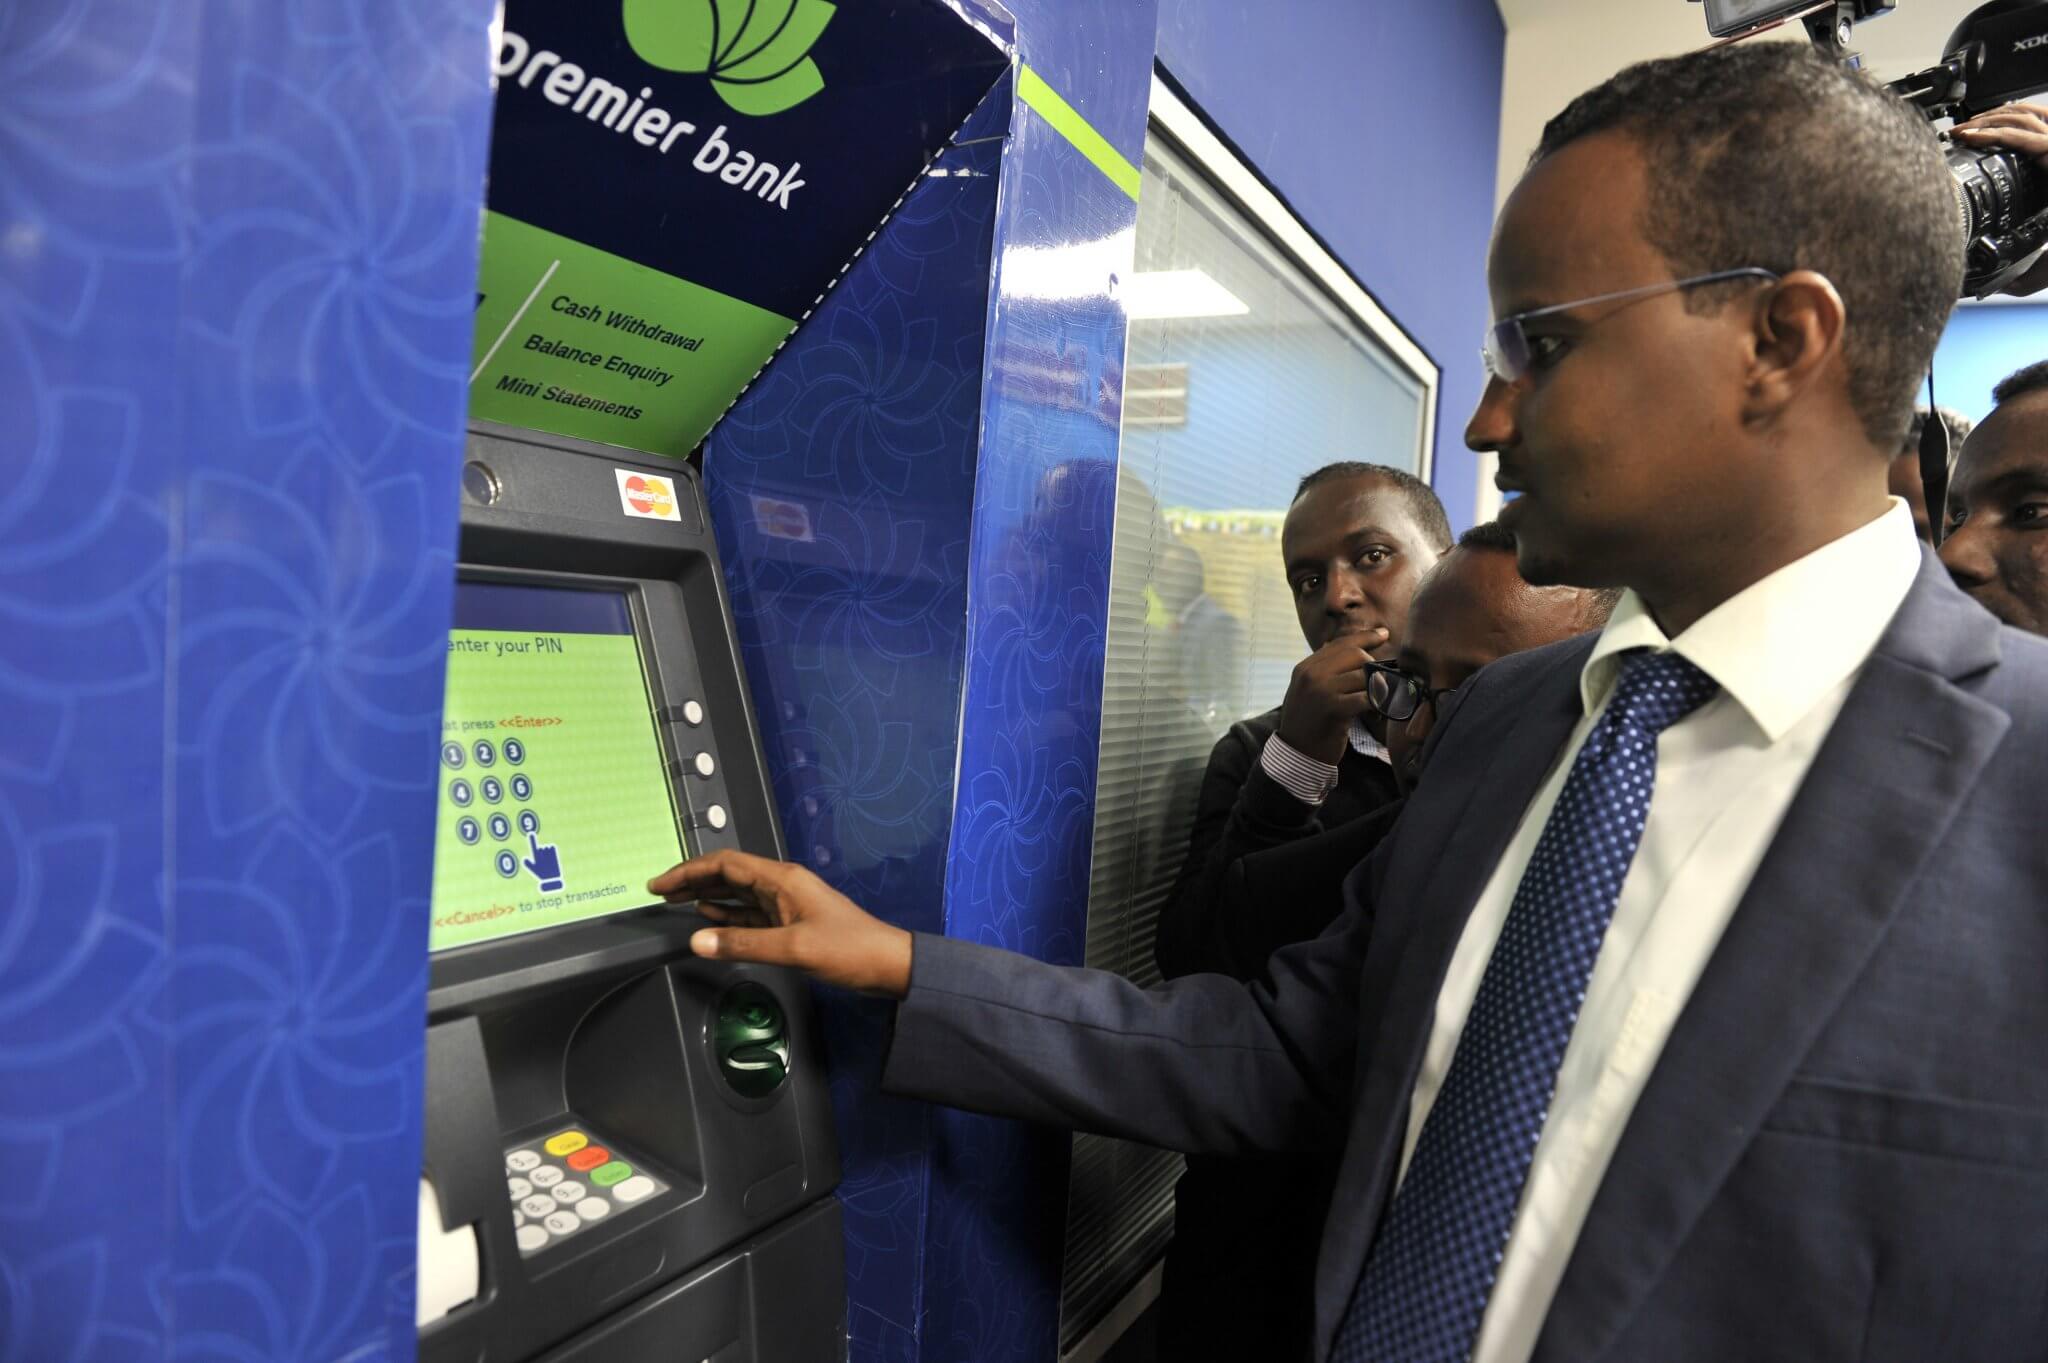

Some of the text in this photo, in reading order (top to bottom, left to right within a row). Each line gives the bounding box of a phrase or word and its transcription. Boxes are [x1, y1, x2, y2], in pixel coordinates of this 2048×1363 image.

[692, 125, 806, 210] bank
[550, 295, 704, 352] Cash Withdrawal
[523, 333, 675, 387] Balance Enquiry
[496, 375, 644, 420] Mini Statements
[447, 637, 563, 657] enter your PIN
[461, 720, 495, 732] press
[519, 902, 533, 913] to
[536, 897, 563, 912] stop
[566, 883, 627, 904] transaction
